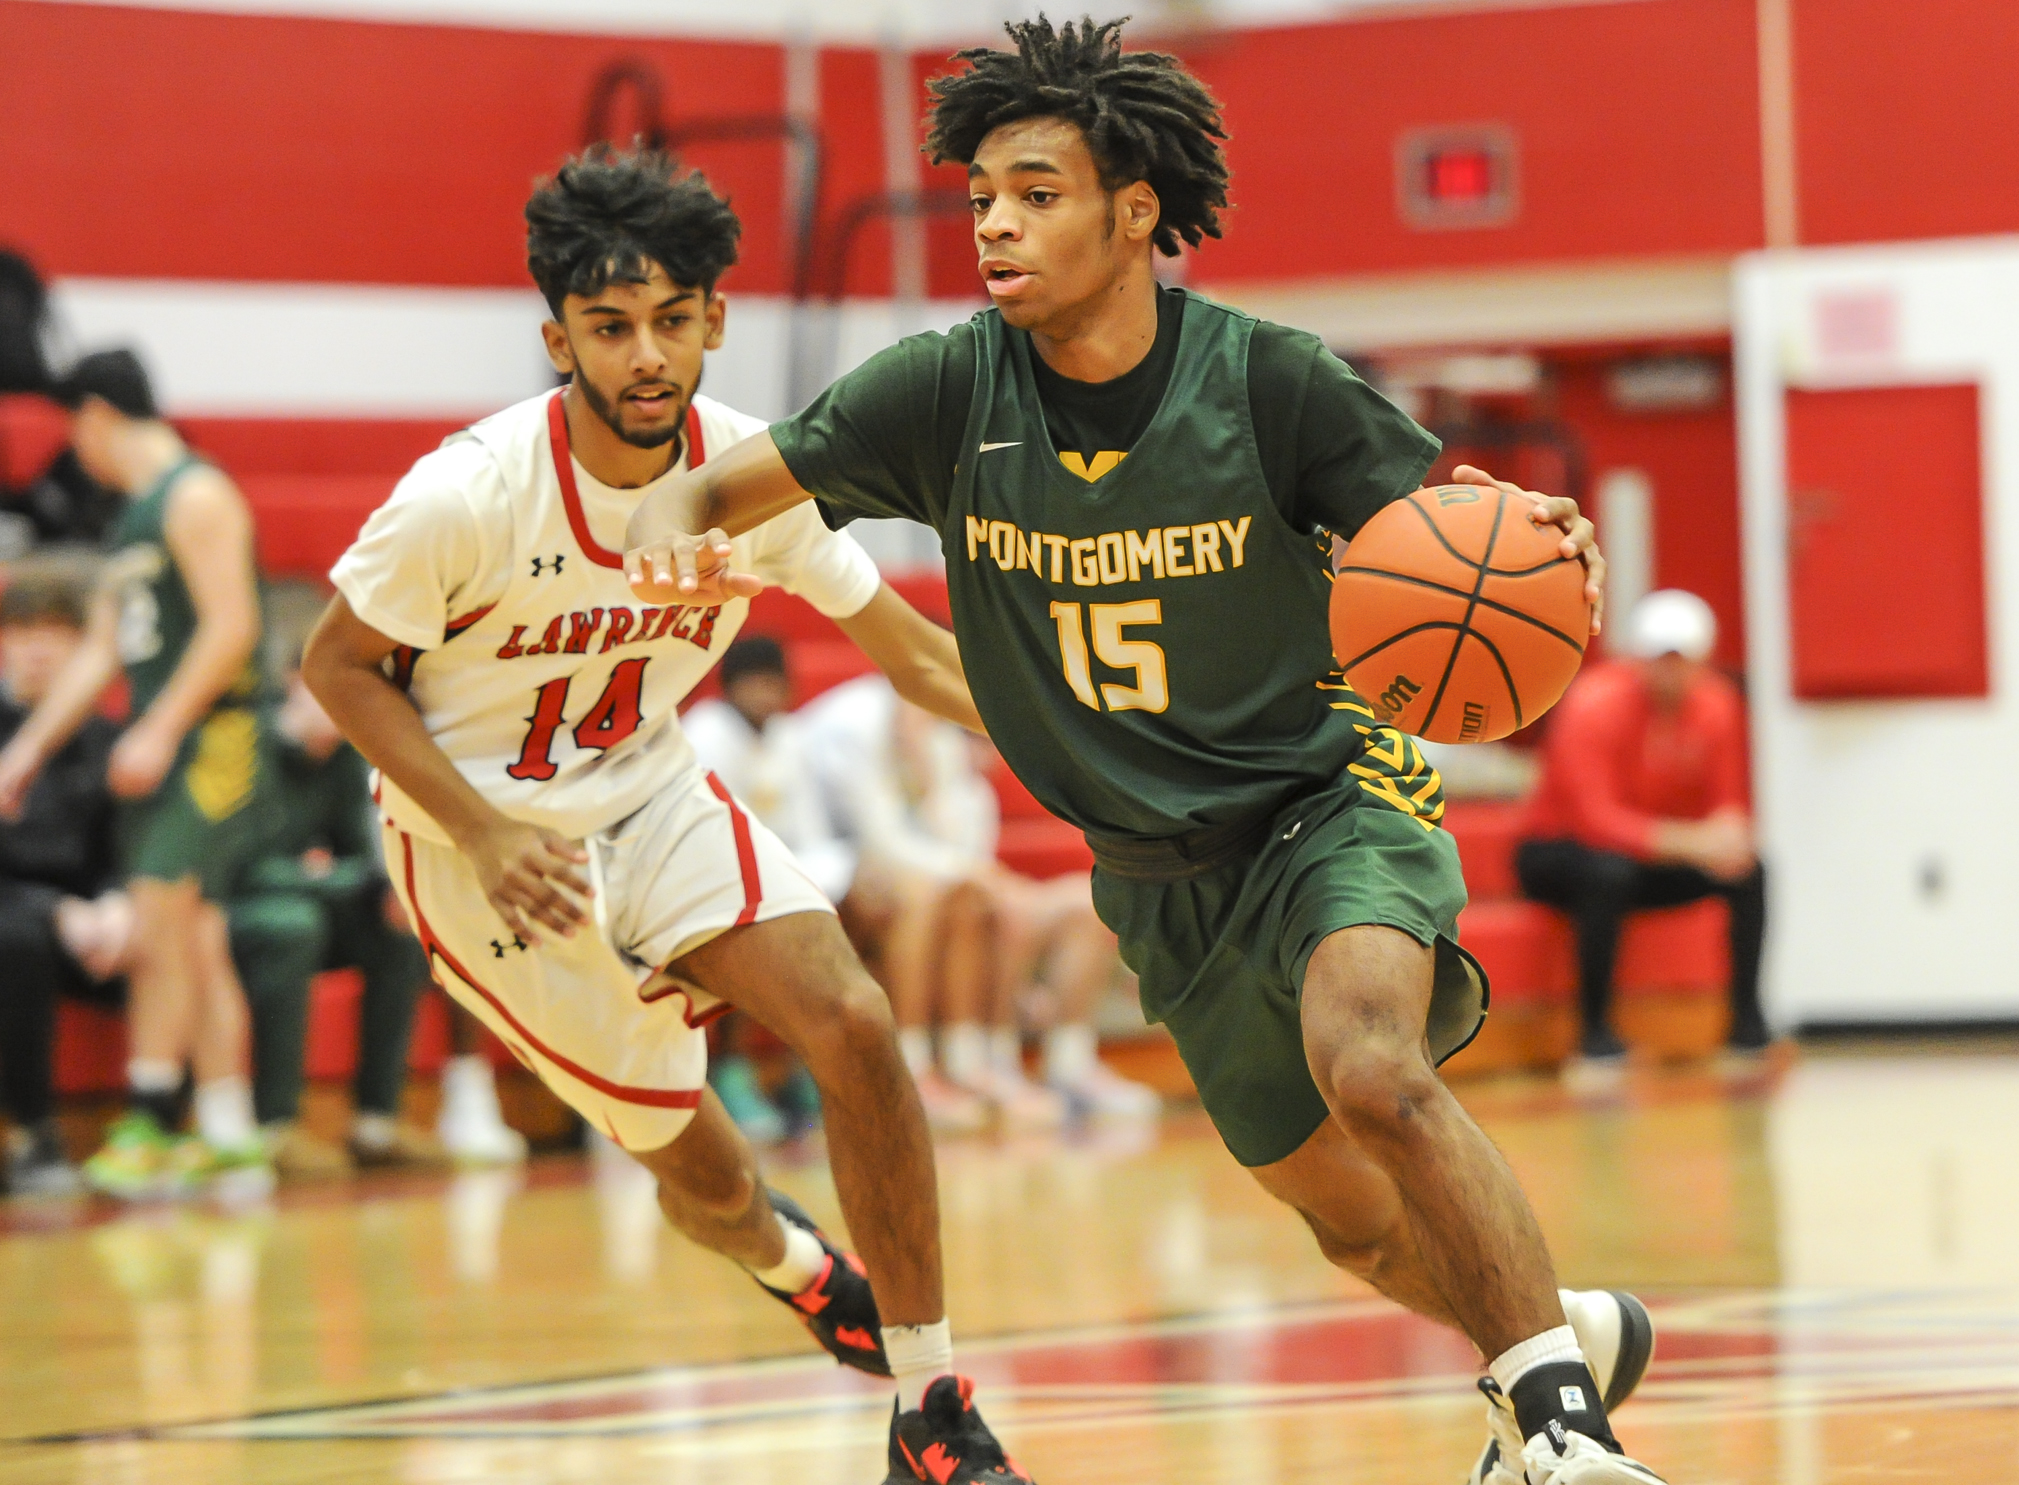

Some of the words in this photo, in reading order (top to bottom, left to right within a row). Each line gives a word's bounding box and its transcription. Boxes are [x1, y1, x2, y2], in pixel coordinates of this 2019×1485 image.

[965, 514, 1252, 587] MONTGOMERY
[1050, 598, 1170, 714] 15
[505, 656, 652, 782] 14
